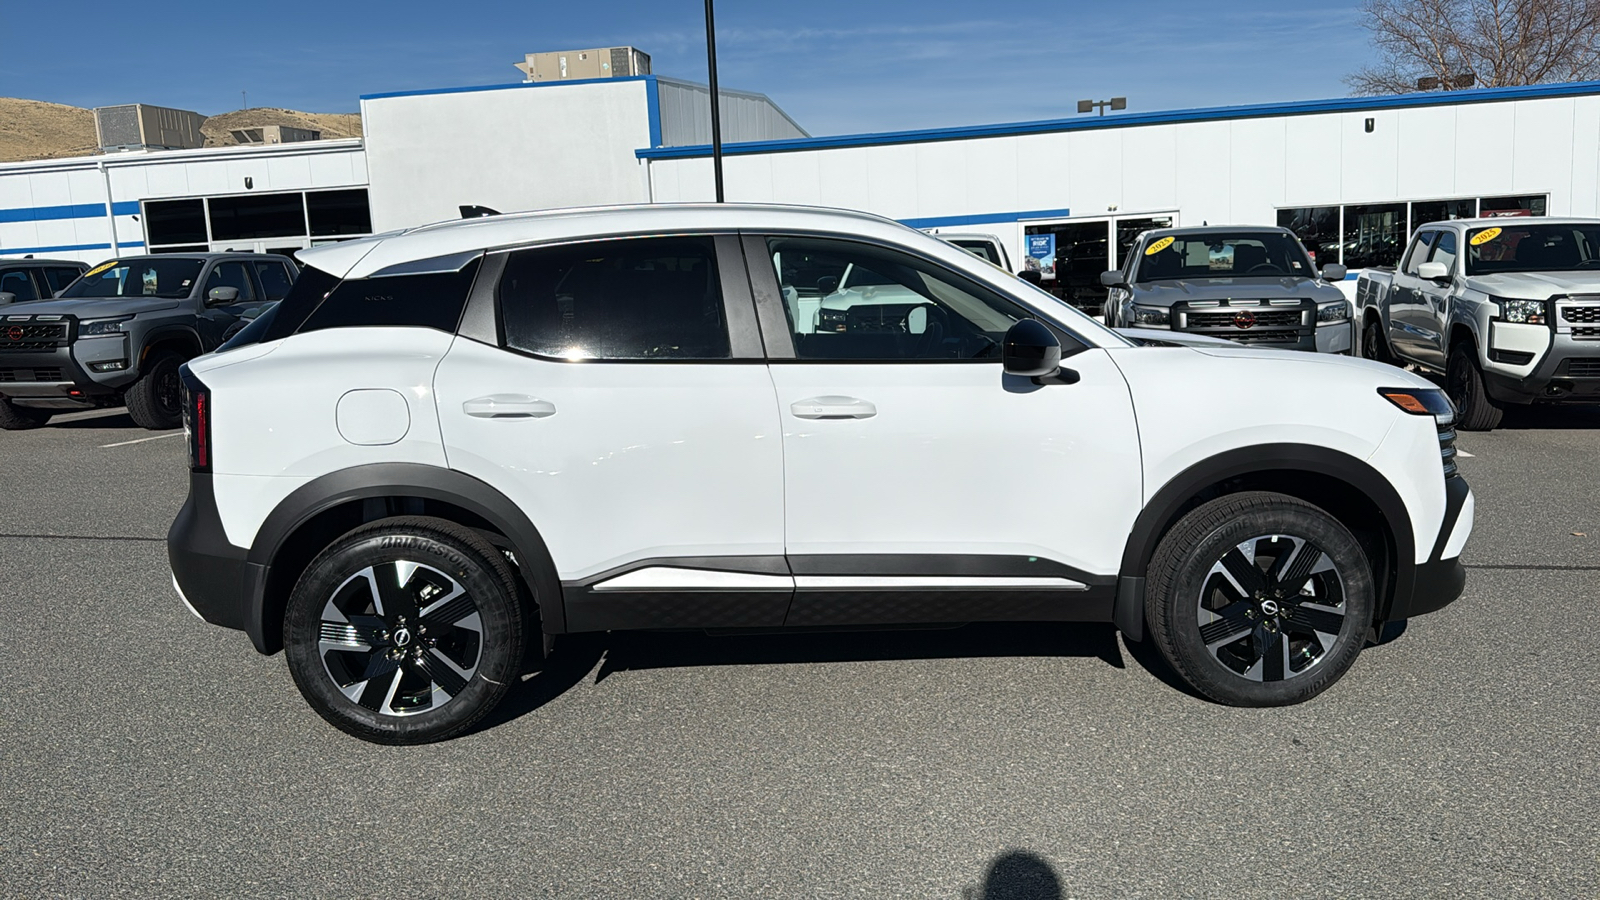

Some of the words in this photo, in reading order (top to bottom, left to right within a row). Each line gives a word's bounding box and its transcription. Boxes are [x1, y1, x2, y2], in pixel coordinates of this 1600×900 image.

[1151, 238, 1170, 252] 2025
[1476, 229, 1497, 243] 2025
[380, 536, 478, 575] BRIDGESTONE
[1178, 519, 1251, 591] BRIDGESTONE
